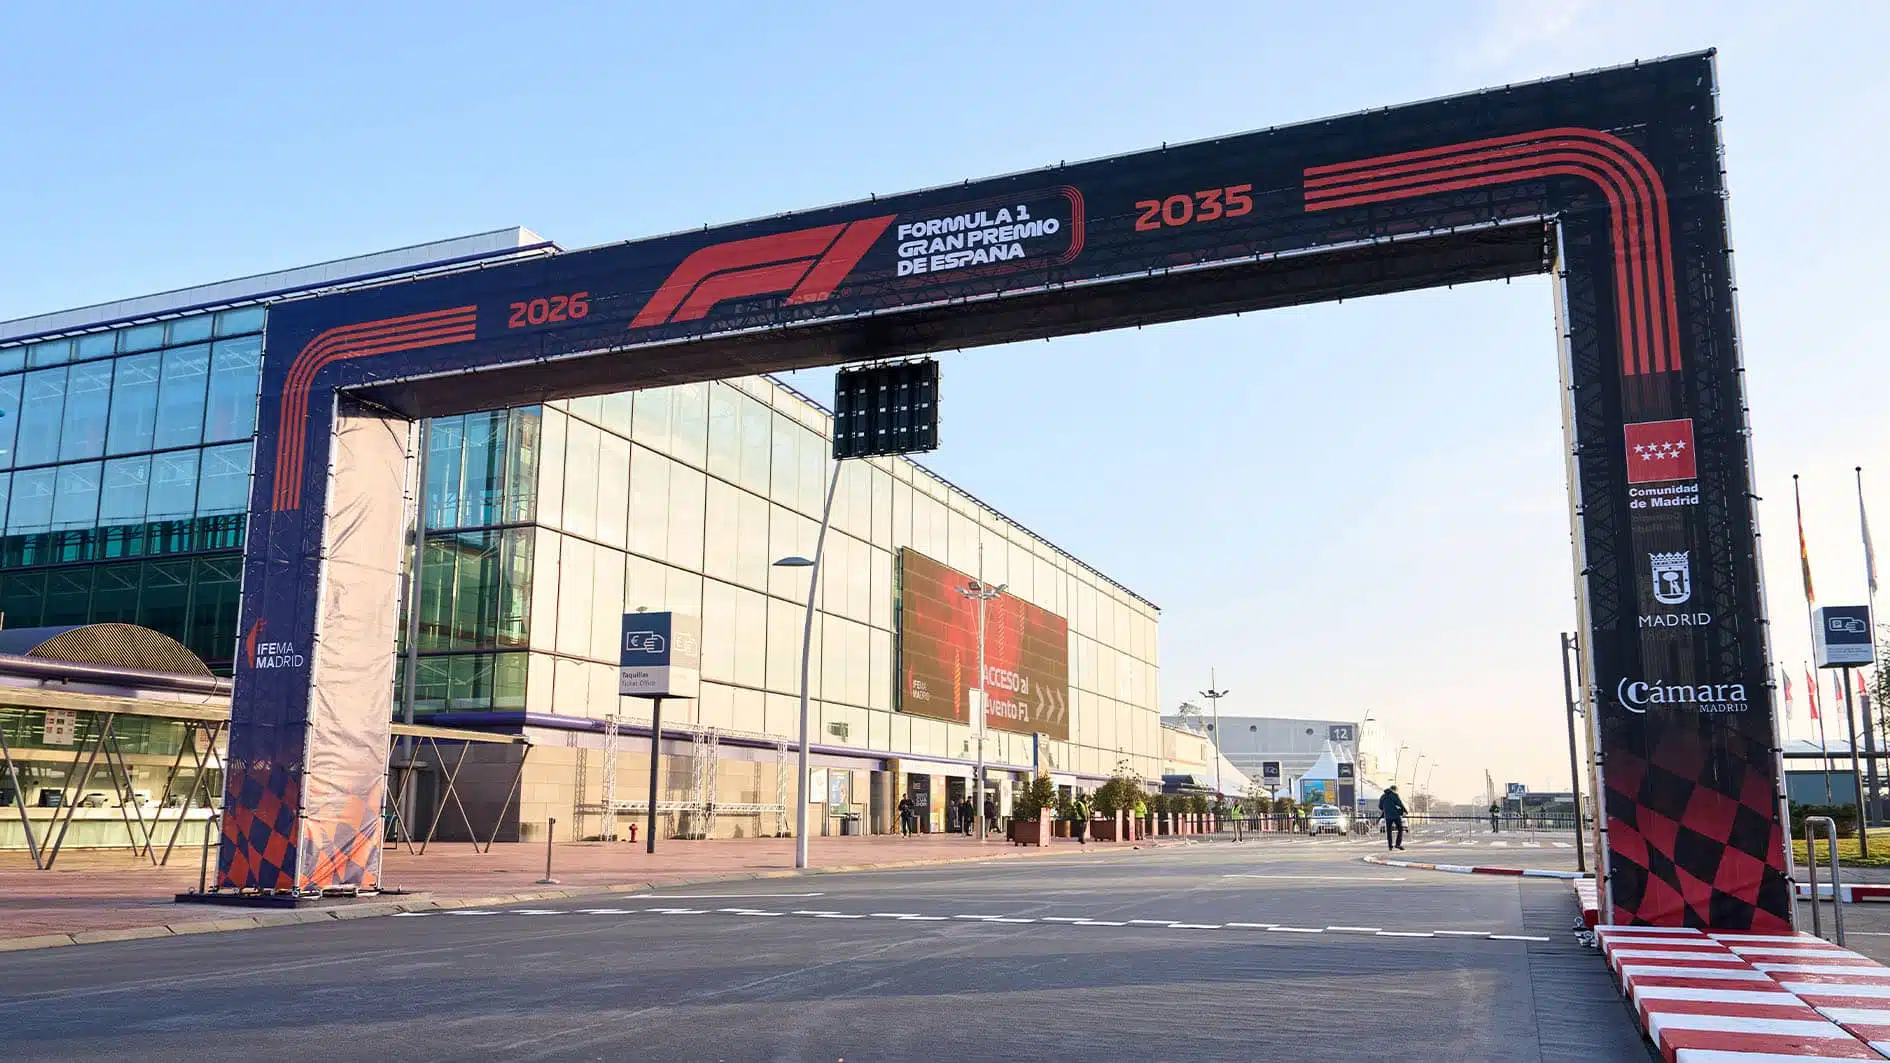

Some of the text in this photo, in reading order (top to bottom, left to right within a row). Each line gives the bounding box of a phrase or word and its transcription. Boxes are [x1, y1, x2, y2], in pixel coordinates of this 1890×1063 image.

[1135, 184, 1253, 231] 2035
[898, 205, 1030, 241] FORMULA 1
[898, 218, 1060, 258] GRAN PREMIO
[897, 243, 1026, 277] DE ESPAÑA
[508, 291, 589, 328] 2026
[1628, 483, 1699, 497] Comunidad
[1629, 494, 1699, 509] de Madrid
[1638, 612, 1711, 628] MADRID
[257, 642, 294, 655] IFEMA
[255, 654, 304, 669] MADRID
[622, 671, 649, 679] Taquillas
[982, 665, 1029, 695] ACCESO al
[1627, 679, 1747, 704] Cámara
[1700, 703, 1748, 713] MADRID
[1333, 728, 1349, 740] 12
